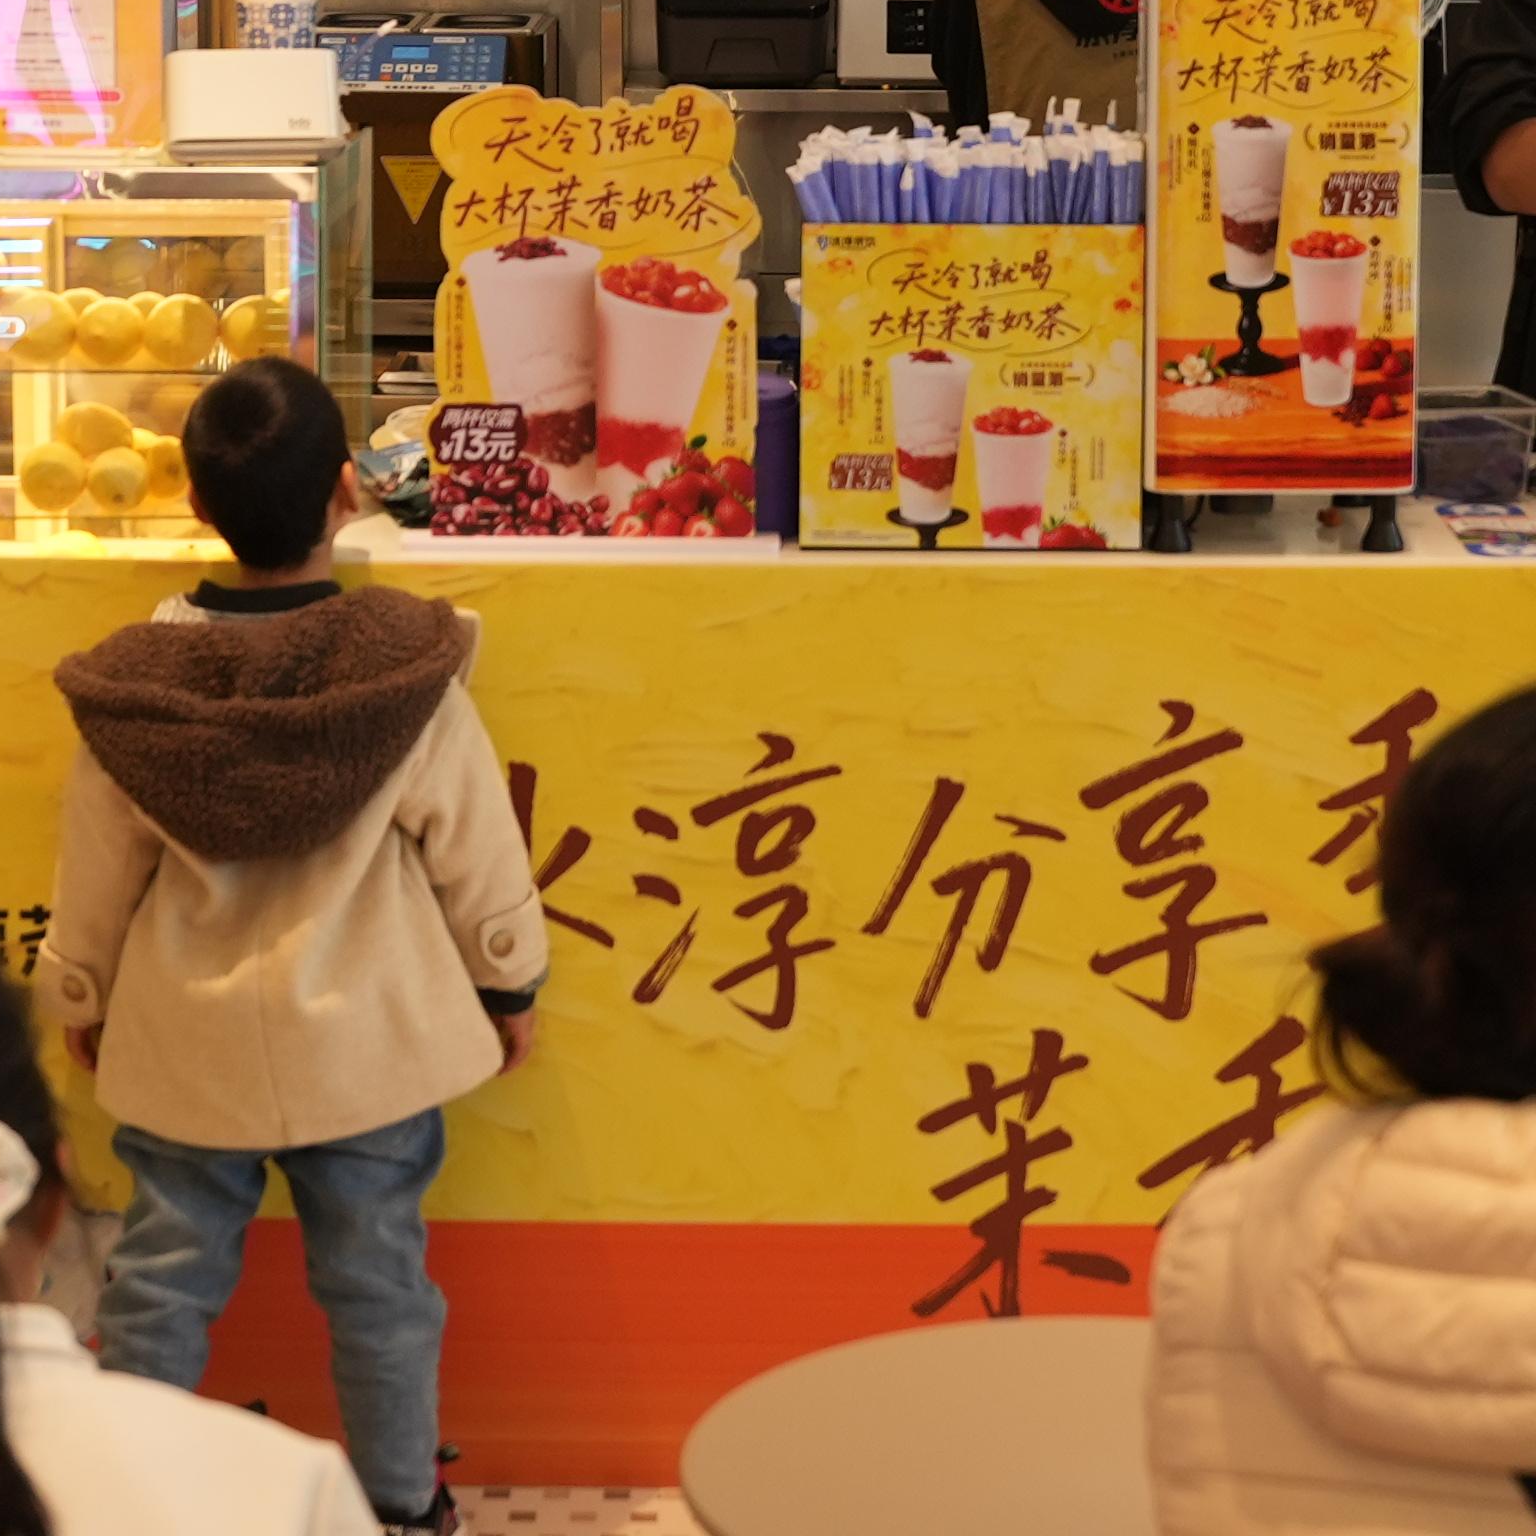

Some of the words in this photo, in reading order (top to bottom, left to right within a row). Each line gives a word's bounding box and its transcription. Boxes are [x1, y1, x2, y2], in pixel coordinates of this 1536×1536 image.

[1176, 44, 1408, 104] 大杯茉香奶茶
[484, 95, 700, 174] 天冷了就喝
[453, 175, 739, 238] 大杯茉香奶茶
[892, 249, 1052, 301] 天冷了就喝
[868, 306, 1081, 346] 大杯茉香奶茶
